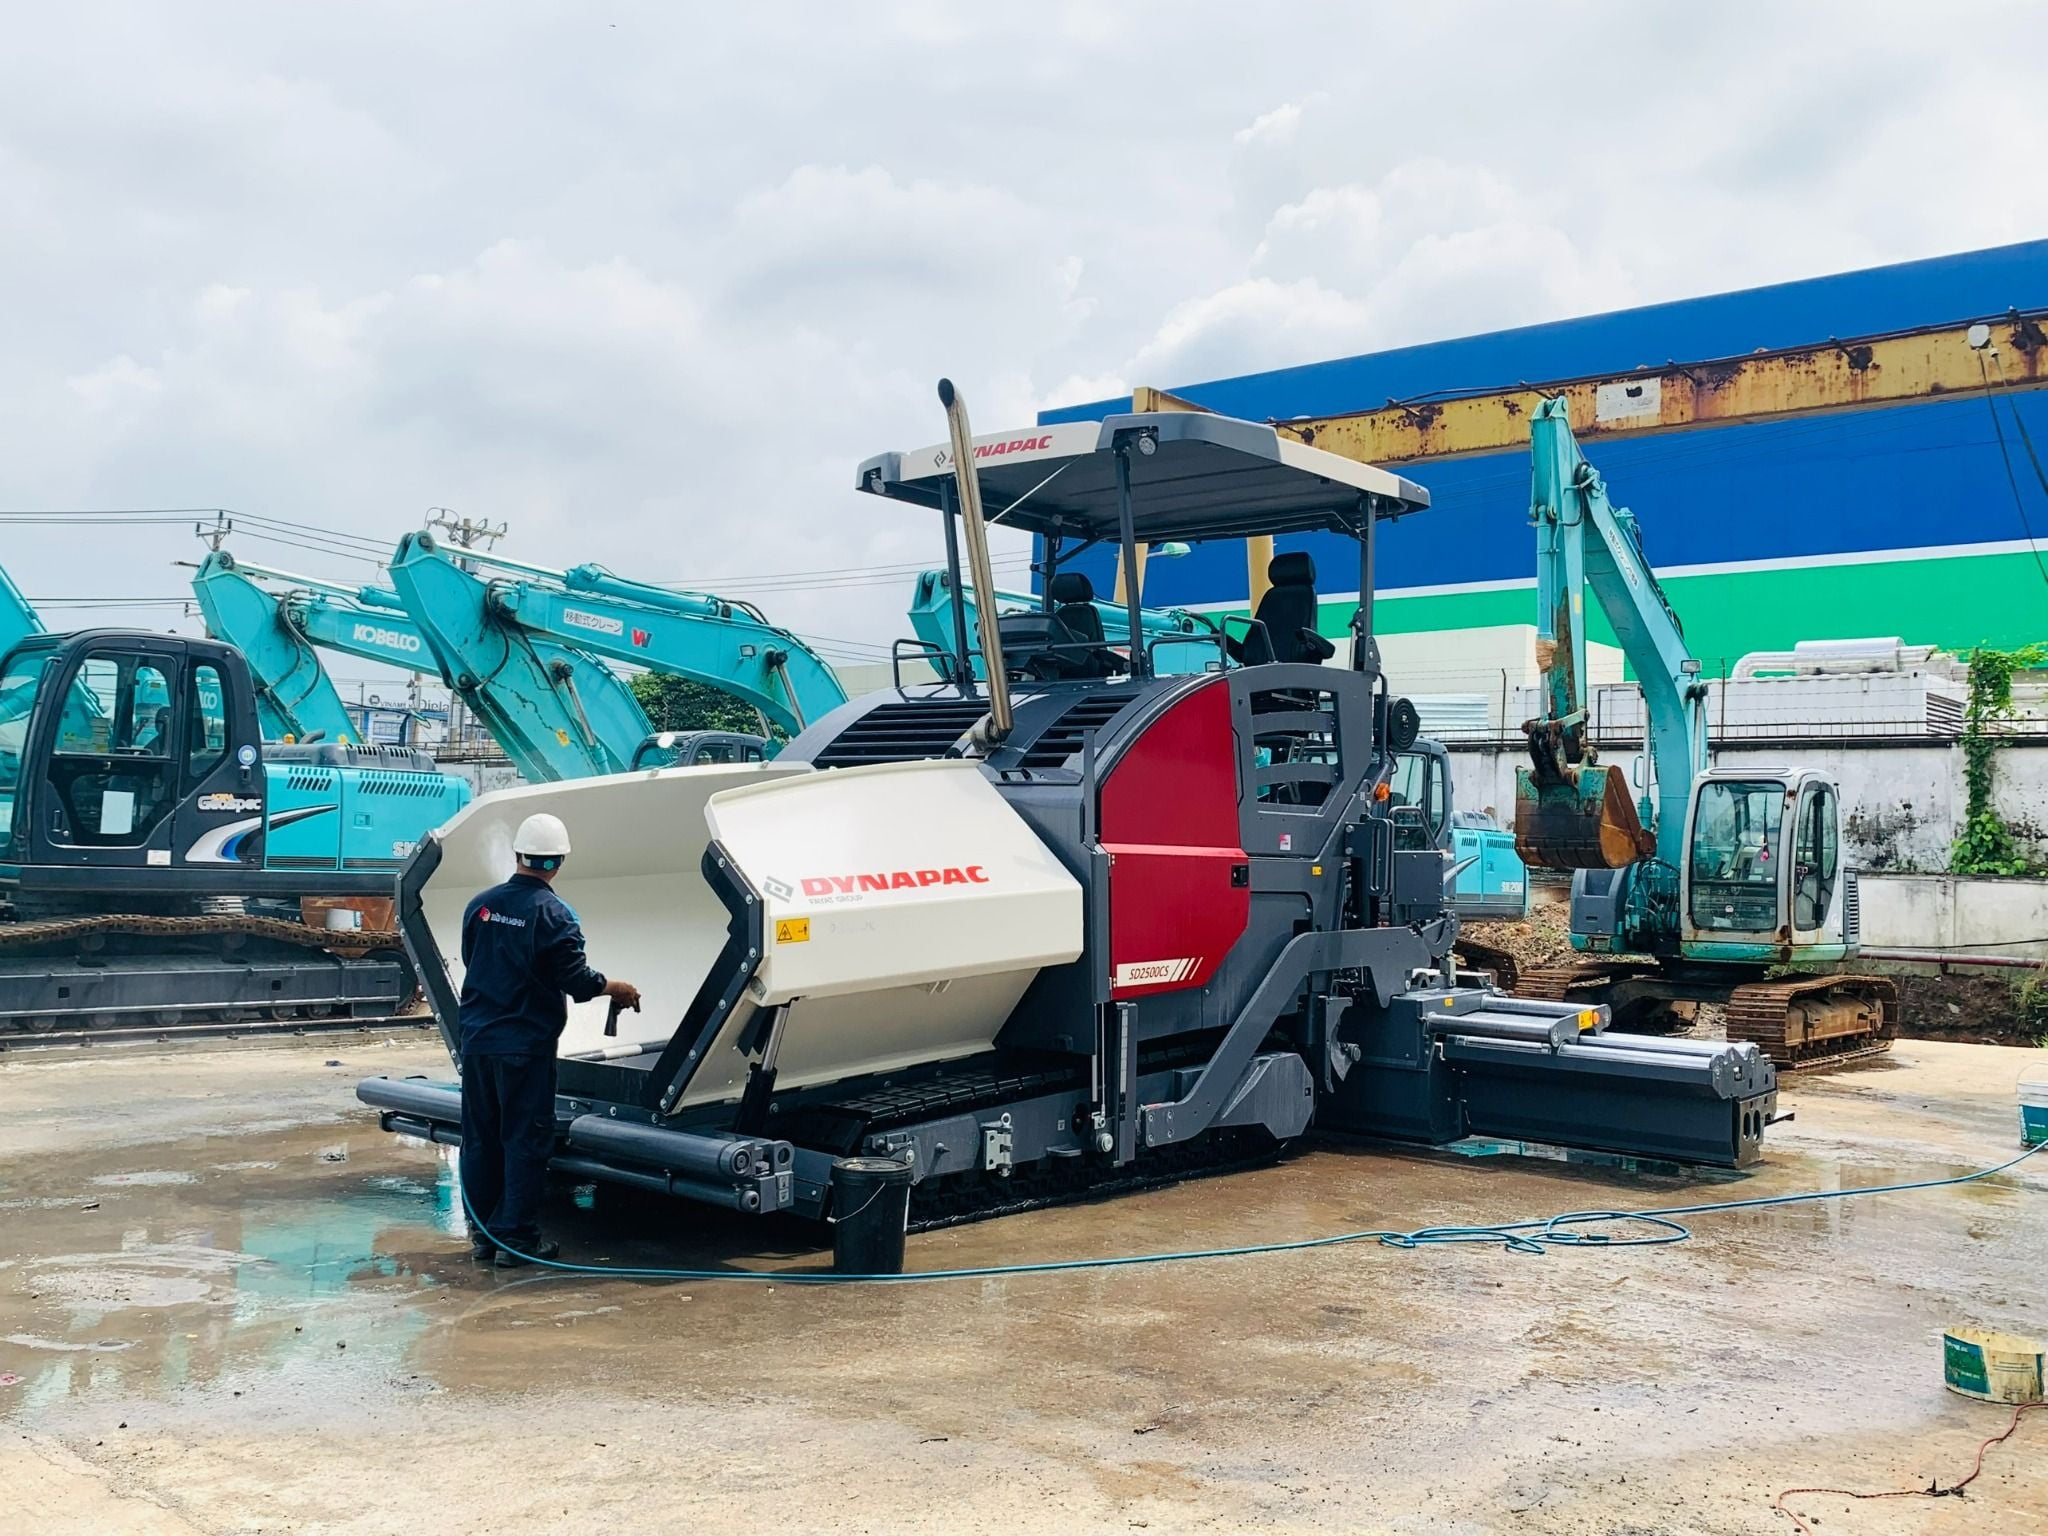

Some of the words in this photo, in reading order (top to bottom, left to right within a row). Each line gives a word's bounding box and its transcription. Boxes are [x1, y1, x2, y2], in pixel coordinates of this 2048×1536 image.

[949, 435, 1053, 463] NAPAC
[353, 623, 420, 652] KOBELCO
[198, 795, 262, 813] Geospec
[800, 866, 989, 896] DYNAPAC
[835, 895, 864, 903] GROUP
[1129, 965, 1169, 980] SD2500CS
